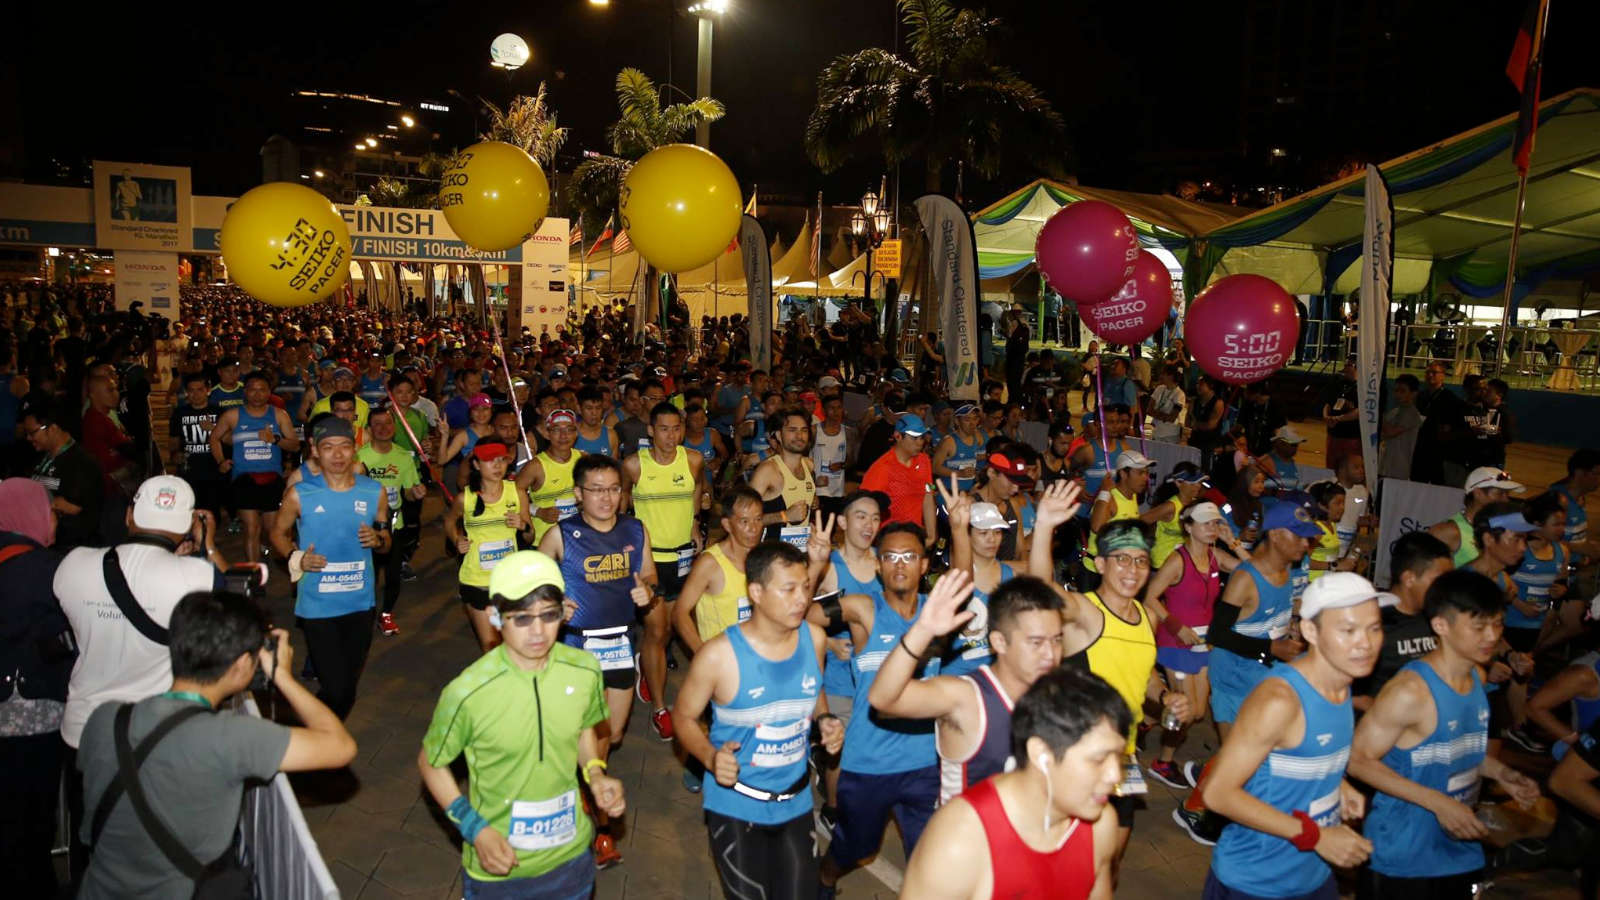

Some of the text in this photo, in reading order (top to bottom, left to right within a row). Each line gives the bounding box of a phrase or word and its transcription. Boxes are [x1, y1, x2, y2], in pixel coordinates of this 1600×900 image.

[340, 209, 434, 236] FINISH
[270, 218, 318, 270] 4:30
[363, 239, 418, 256] FINISH
[289, 230, 335, 290] SEIKO
[309, 245, 345, 294] PACER
[942, 219, 970, 357] Standard Chartered
[1091, 300, 1147, 319] SEIKO
[1099, 316, 1144, 331] PACER
[1224, 331, 1280, 354] 5:00
[1217, 353, 1282, 369] SEIKO
[1223, 369, 1273, 379] PACER
[583, 552, 630, 573] CARI
[585, 569, 630, 584] RUNNERS
